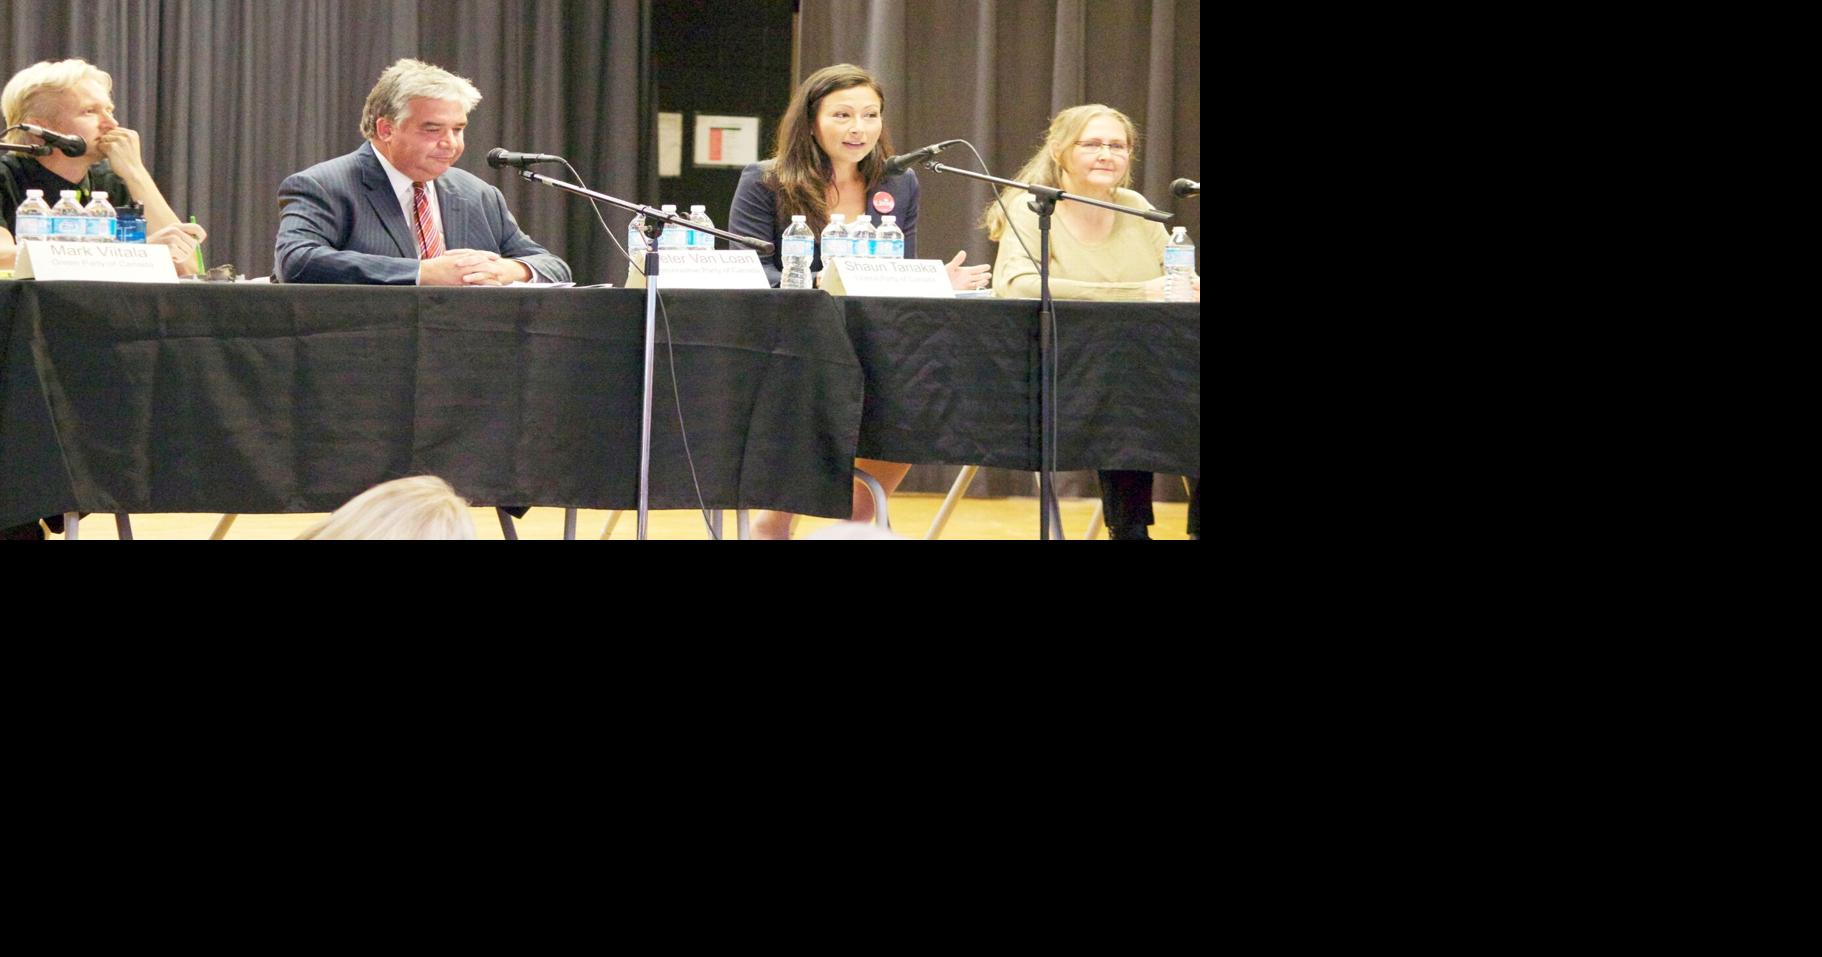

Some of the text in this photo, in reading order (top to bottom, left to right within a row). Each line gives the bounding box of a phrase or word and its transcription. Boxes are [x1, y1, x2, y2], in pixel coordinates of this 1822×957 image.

[50, 244, 93, 256] Mark
[659, 253, 754, 264] eter Van Loan
[845, 260, 888, 272] Shaun
